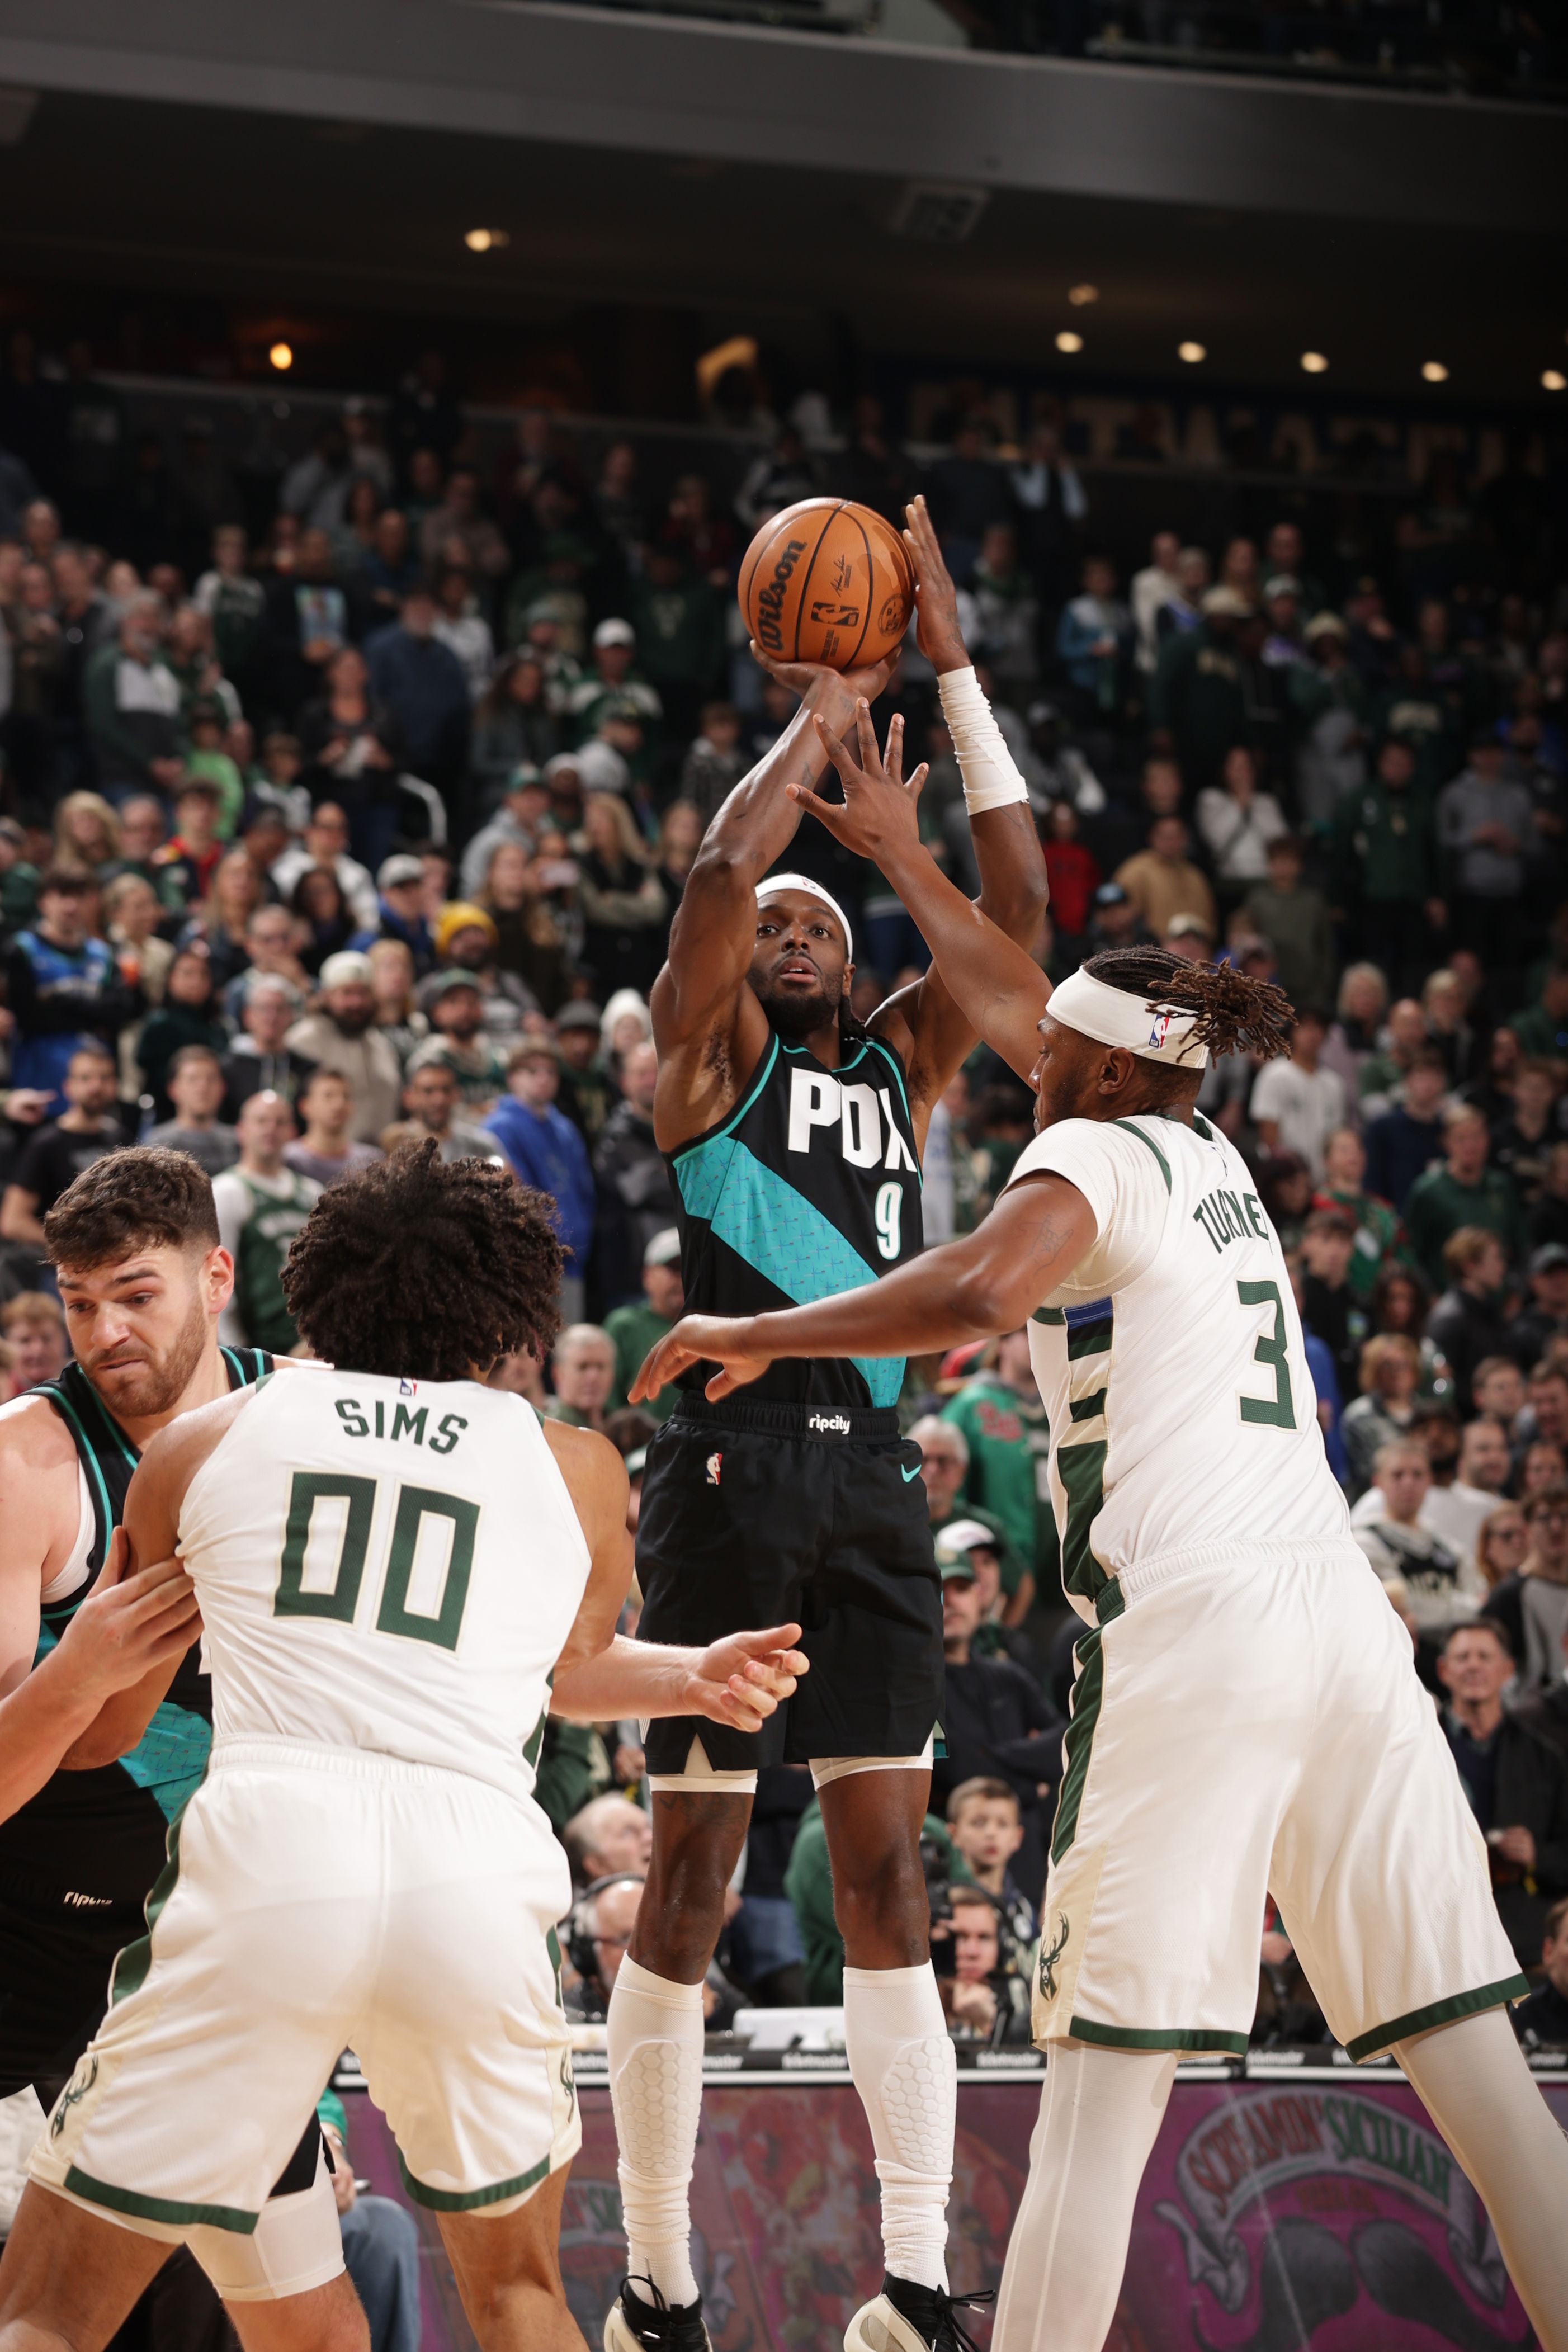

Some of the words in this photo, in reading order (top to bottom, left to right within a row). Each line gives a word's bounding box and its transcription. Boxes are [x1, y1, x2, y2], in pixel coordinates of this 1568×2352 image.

[758, 540, 807, 651] Wilson
[788, 1067, 918, 1172] PDX
[875, 1181, 903, 1260] 9
[1193, 1189, 1273, 1255] TURNE
[1235, 1277, 1302, 1434] 3
[335, 1398, 469, 1455] SIMS
[809, 1413, 851, 1435] ripcity
[270, 1466, 485, 1660] 00
[1324, 2096, 1452, 2208] SICILIAN
